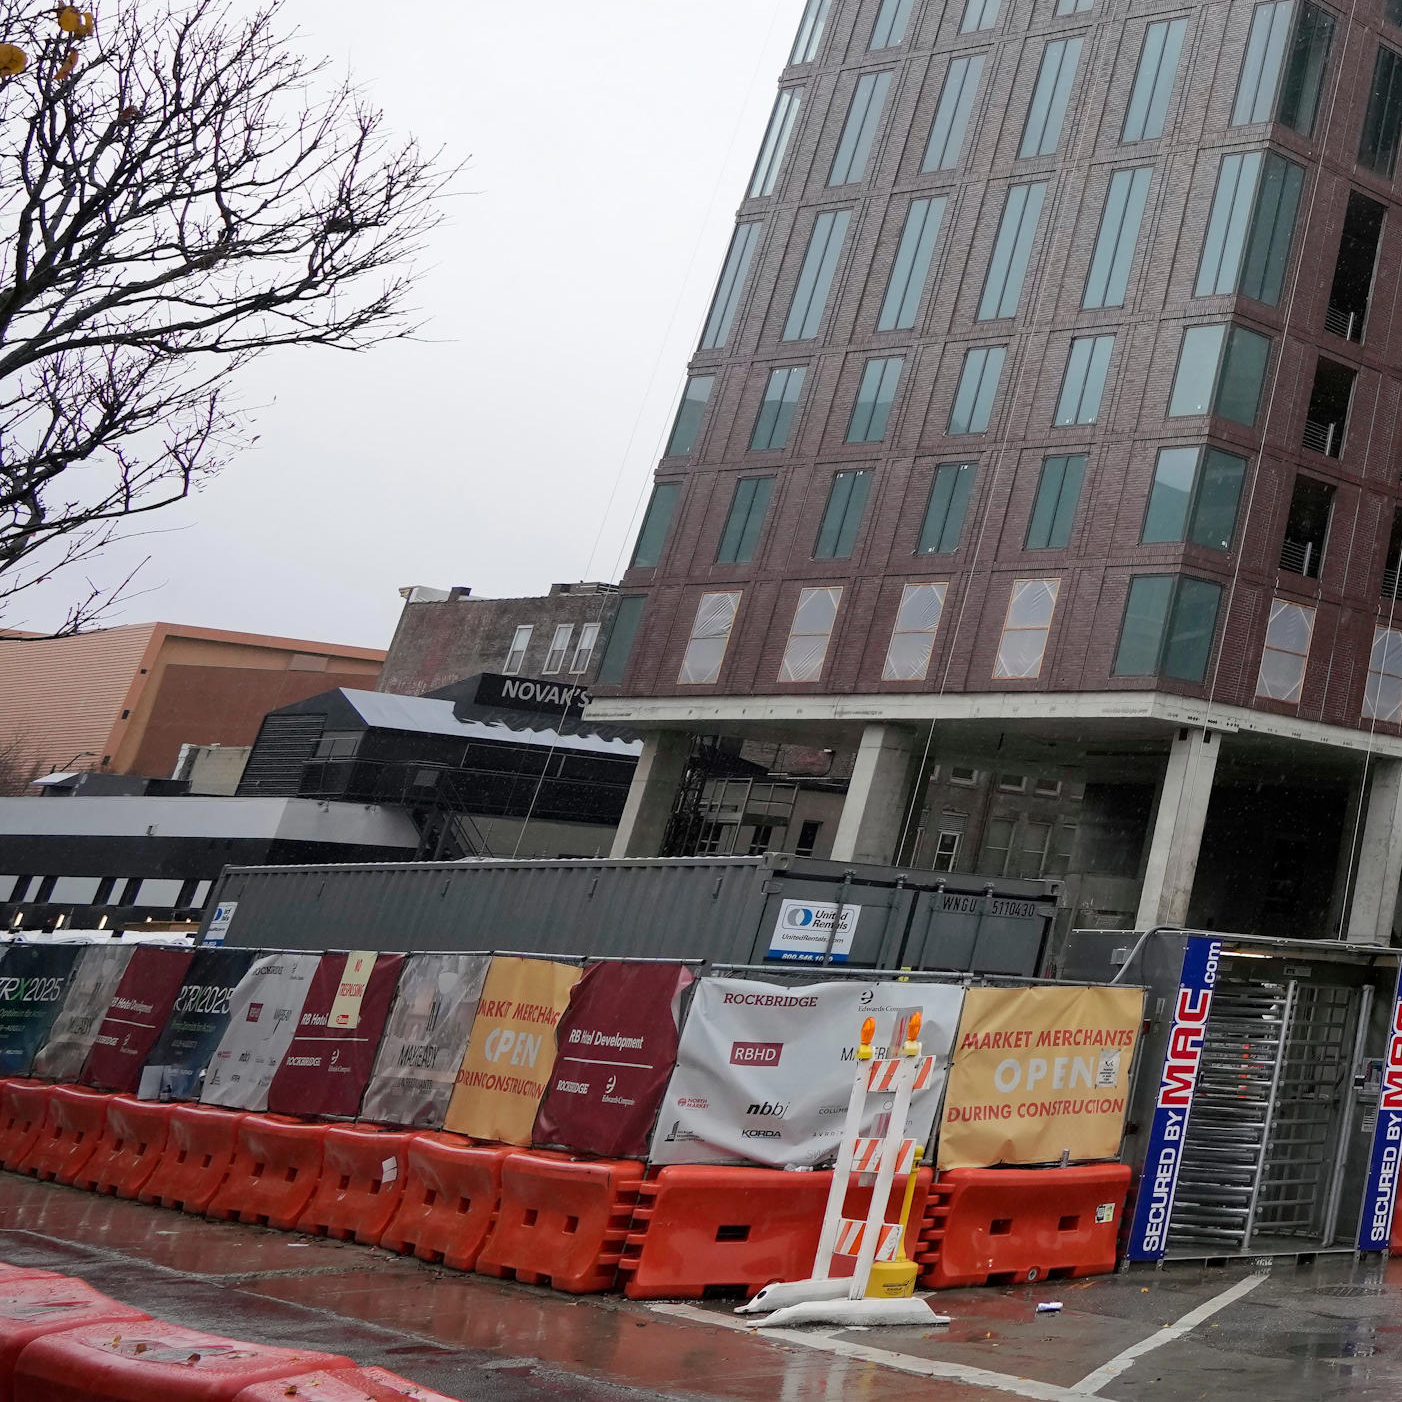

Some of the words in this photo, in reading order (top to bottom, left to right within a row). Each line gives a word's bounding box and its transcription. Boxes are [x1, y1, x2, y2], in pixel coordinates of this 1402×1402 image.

[501, 679, 590, 708] NOVAK'S
[812, 919, 848, 930] Rentls
[815, 910, 848, 920] Unitd
[781, 933, 844, 943] UnitedRentals.om
[722, 992, 818, 1008] ROCKBRIDGE
[594, 1031, 644, 1051] Development
[960, 1029, 1033, 1050] MARKET
[1036, 1028, 1134, 1047] MERCHANTS
[734, 1046, 777, 1062] RBHD
[994, 1055, 1095, 1094] OPEN
[746, 1101, 790, 1119] nbbj
[947, 1103, 1012, 1123] DURING
[1017, 1098, 1124, 1119] CONSTRUCTION
[741, 1129, 782, 1139] KORDA
[1143, 1147, 1176, 1252] SECURED
[1164, 1110, 1184, 1141] BY
[1371, 1152, 1398, 1242] SECURED
[1386, 1112, 1402, 1141] BY
